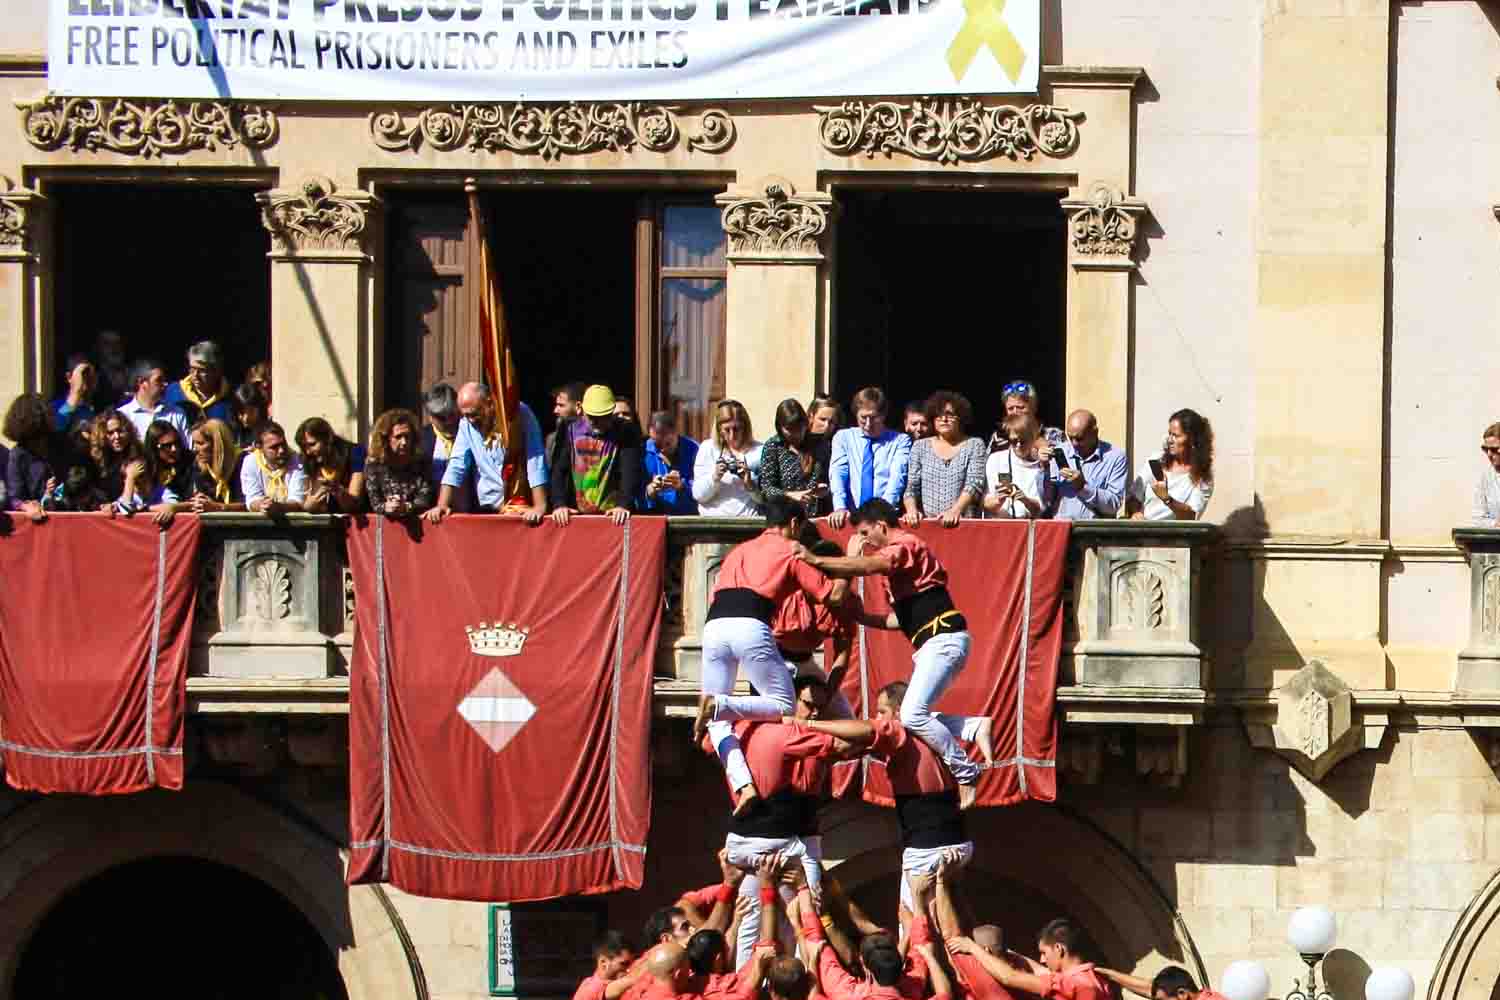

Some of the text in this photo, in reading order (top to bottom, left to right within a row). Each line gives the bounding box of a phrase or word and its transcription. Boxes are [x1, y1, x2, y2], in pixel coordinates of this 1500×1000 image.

[67, 26, 689, 70] FREE POLITICAL PRISIONERS AND EXILES
